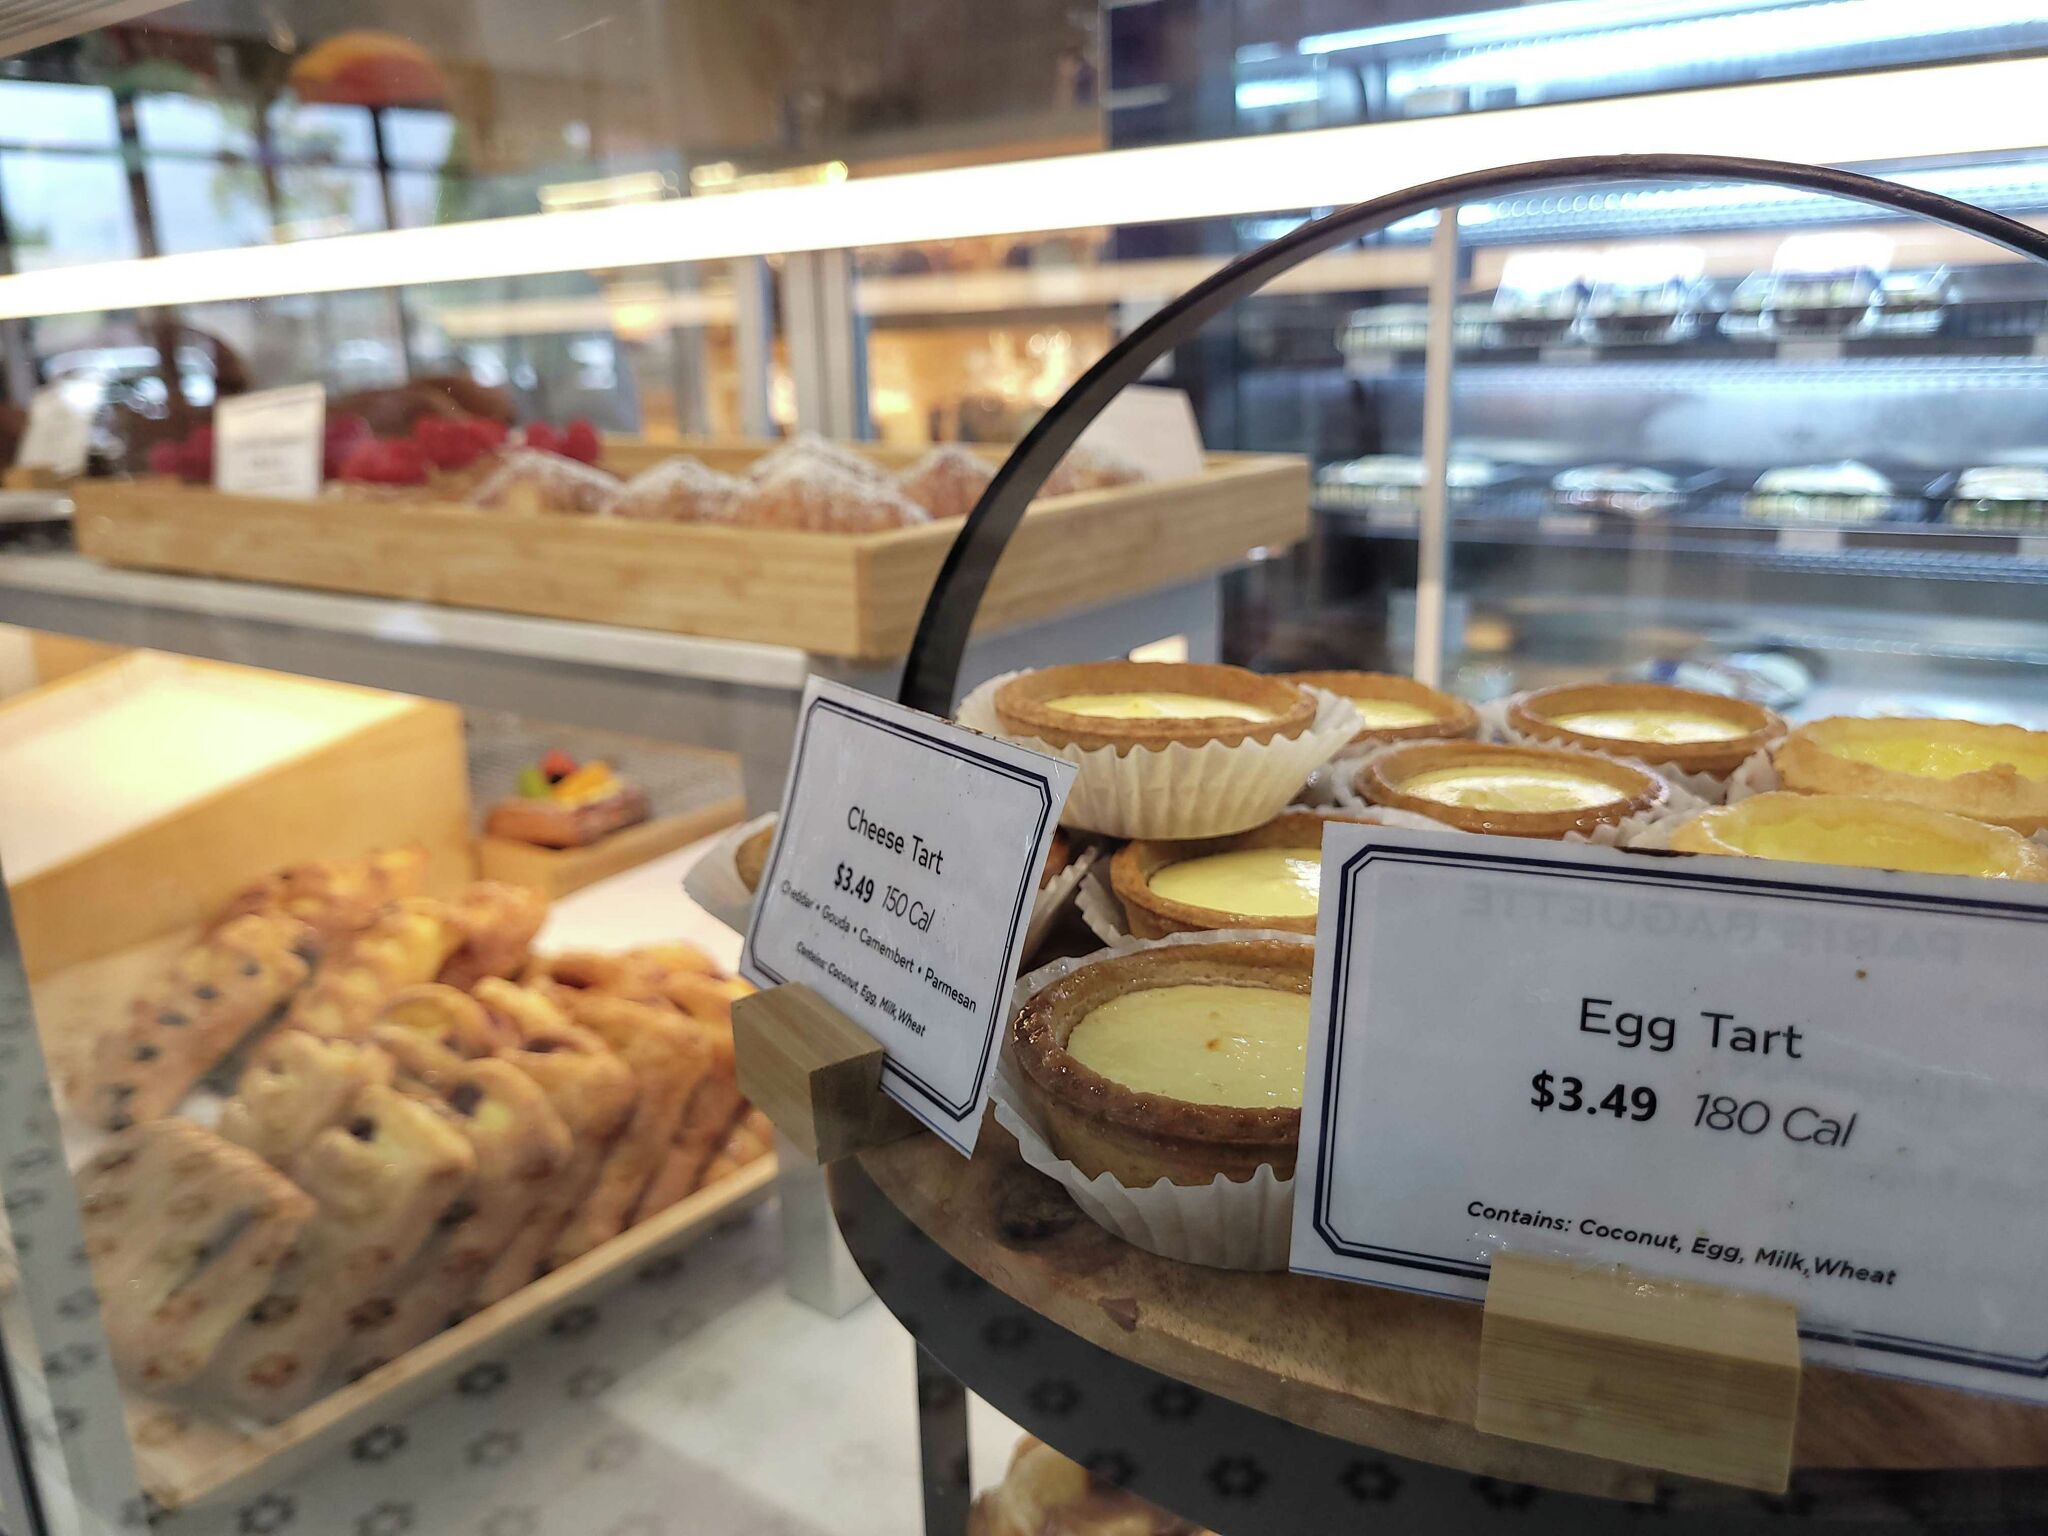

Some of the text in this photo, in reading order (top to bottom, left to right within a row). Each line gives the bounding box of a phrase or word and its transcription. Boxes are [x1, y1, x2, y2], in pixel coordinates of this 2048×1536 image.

[847, 806, 944, 875] Cheese Tart
[834, 861, 936, 933] $3.49 150 Cal
[822, 904, 850, 933] Gouda
[859, 927, 915, 974] Camembert
[924, 967, 977, 1014] Parmesan
[827, 962, 859, 994] Coconut,
[859, 985, 878, 1008] Egg,
[1580, 997, 1803, 1059] Egg Tart
[1531, 1069, 1858, 1147] $3.49 180 Cal
[1466, 1201, 1572, 1232] Contains:
[1579, 1219, 1682, 1254] Coconut,
[1691, 1237, 1745, 1265] Egg,
